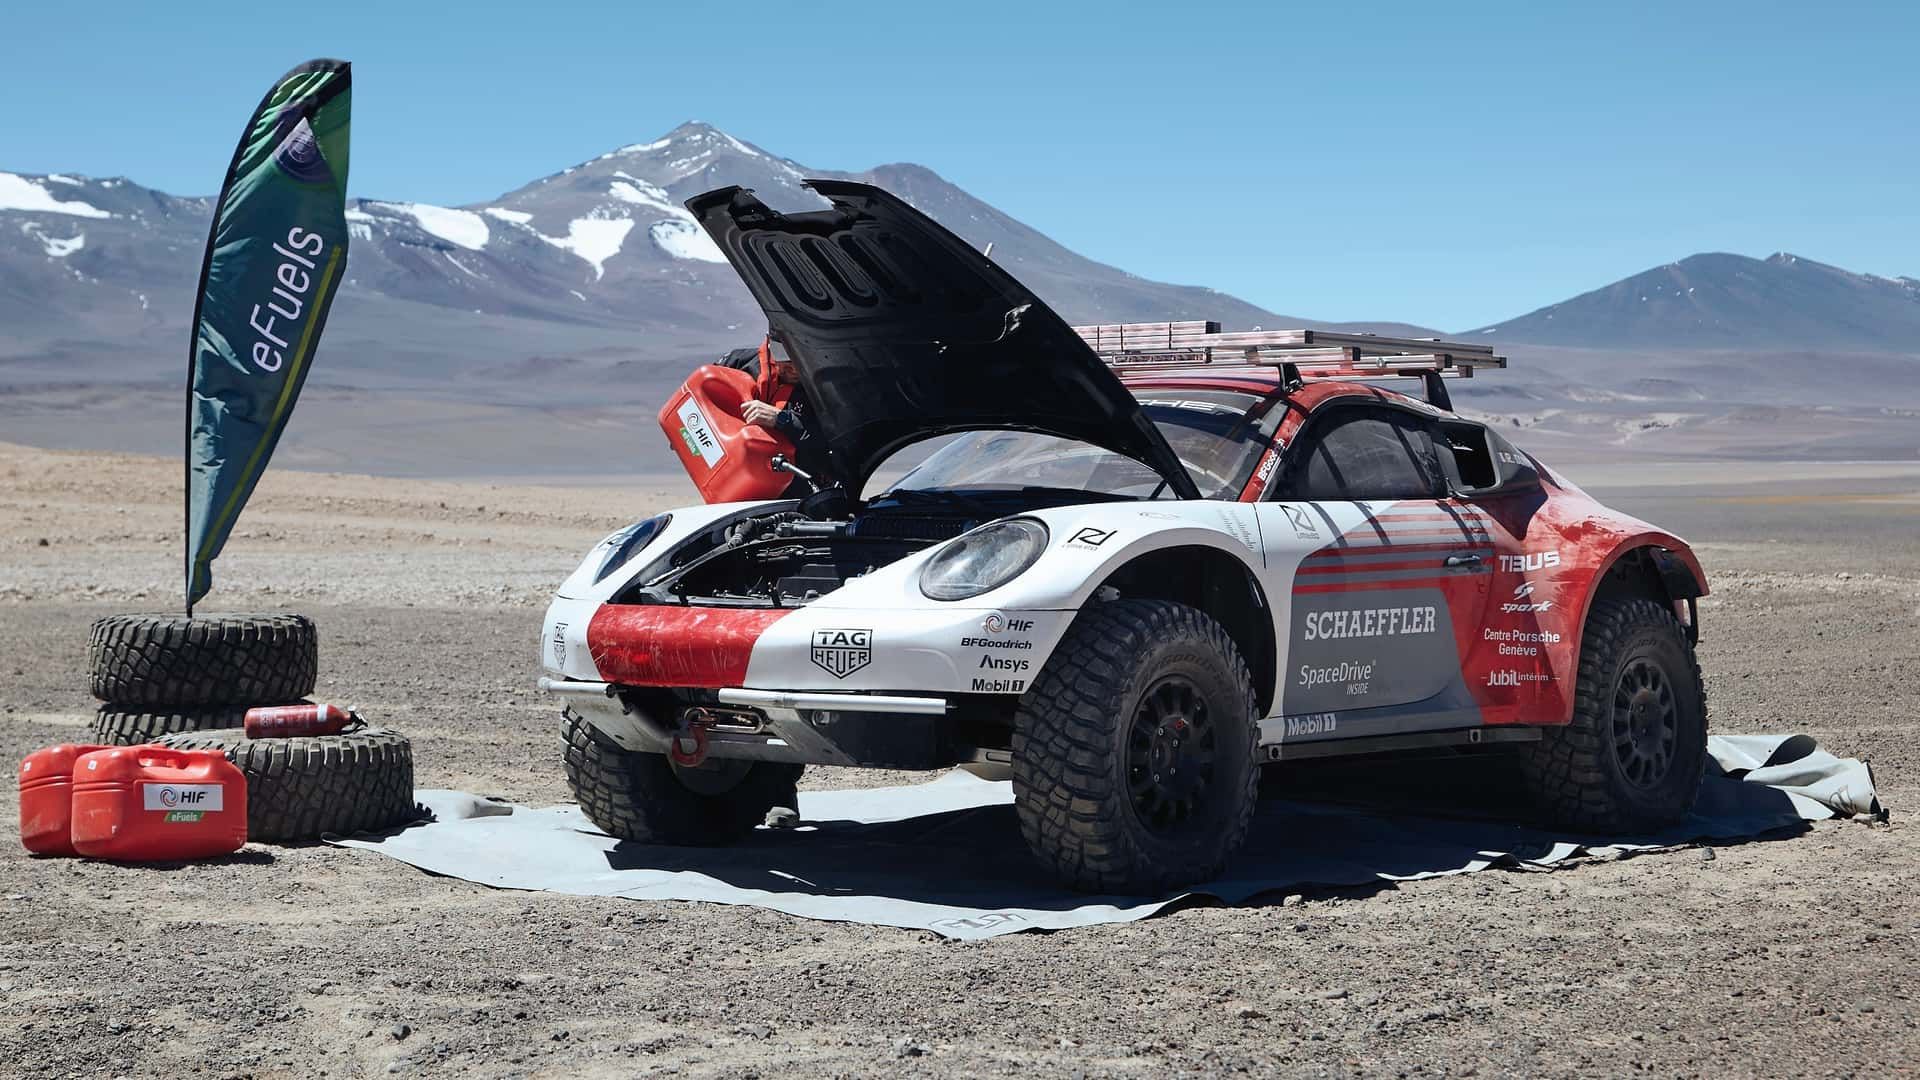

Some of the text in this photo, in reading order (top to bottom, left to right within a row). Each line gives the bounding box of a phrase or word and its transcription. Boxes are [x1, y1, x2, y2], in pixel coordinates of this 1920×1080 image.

[250, 227, 323, 373] eFuels
[695, 428, 713, 448] HIF
[1500, 600, 1552, 613] spark
[1007, 619, 1034, 632] HIF
[1304, 606, 1436, 641] SCHAEFFLER
[818, 631, 866, 646] TAG
[1484, 628, 1560, 643] Centre Porsche
[961, 637, 1032, 650] BFGoodrich
[1498, 643, 1537, 656] Genève
[815, 650, 867, 675] HEUER
[979, 654, 1029, 673] Ansys
[971, 678, 1025, 692] Mobil 1
[1346, 683, 1369, 696] INSIDE
[1287, 713, 1336, 737] Mobil 1
[181, 791, 205, 803] HIF
